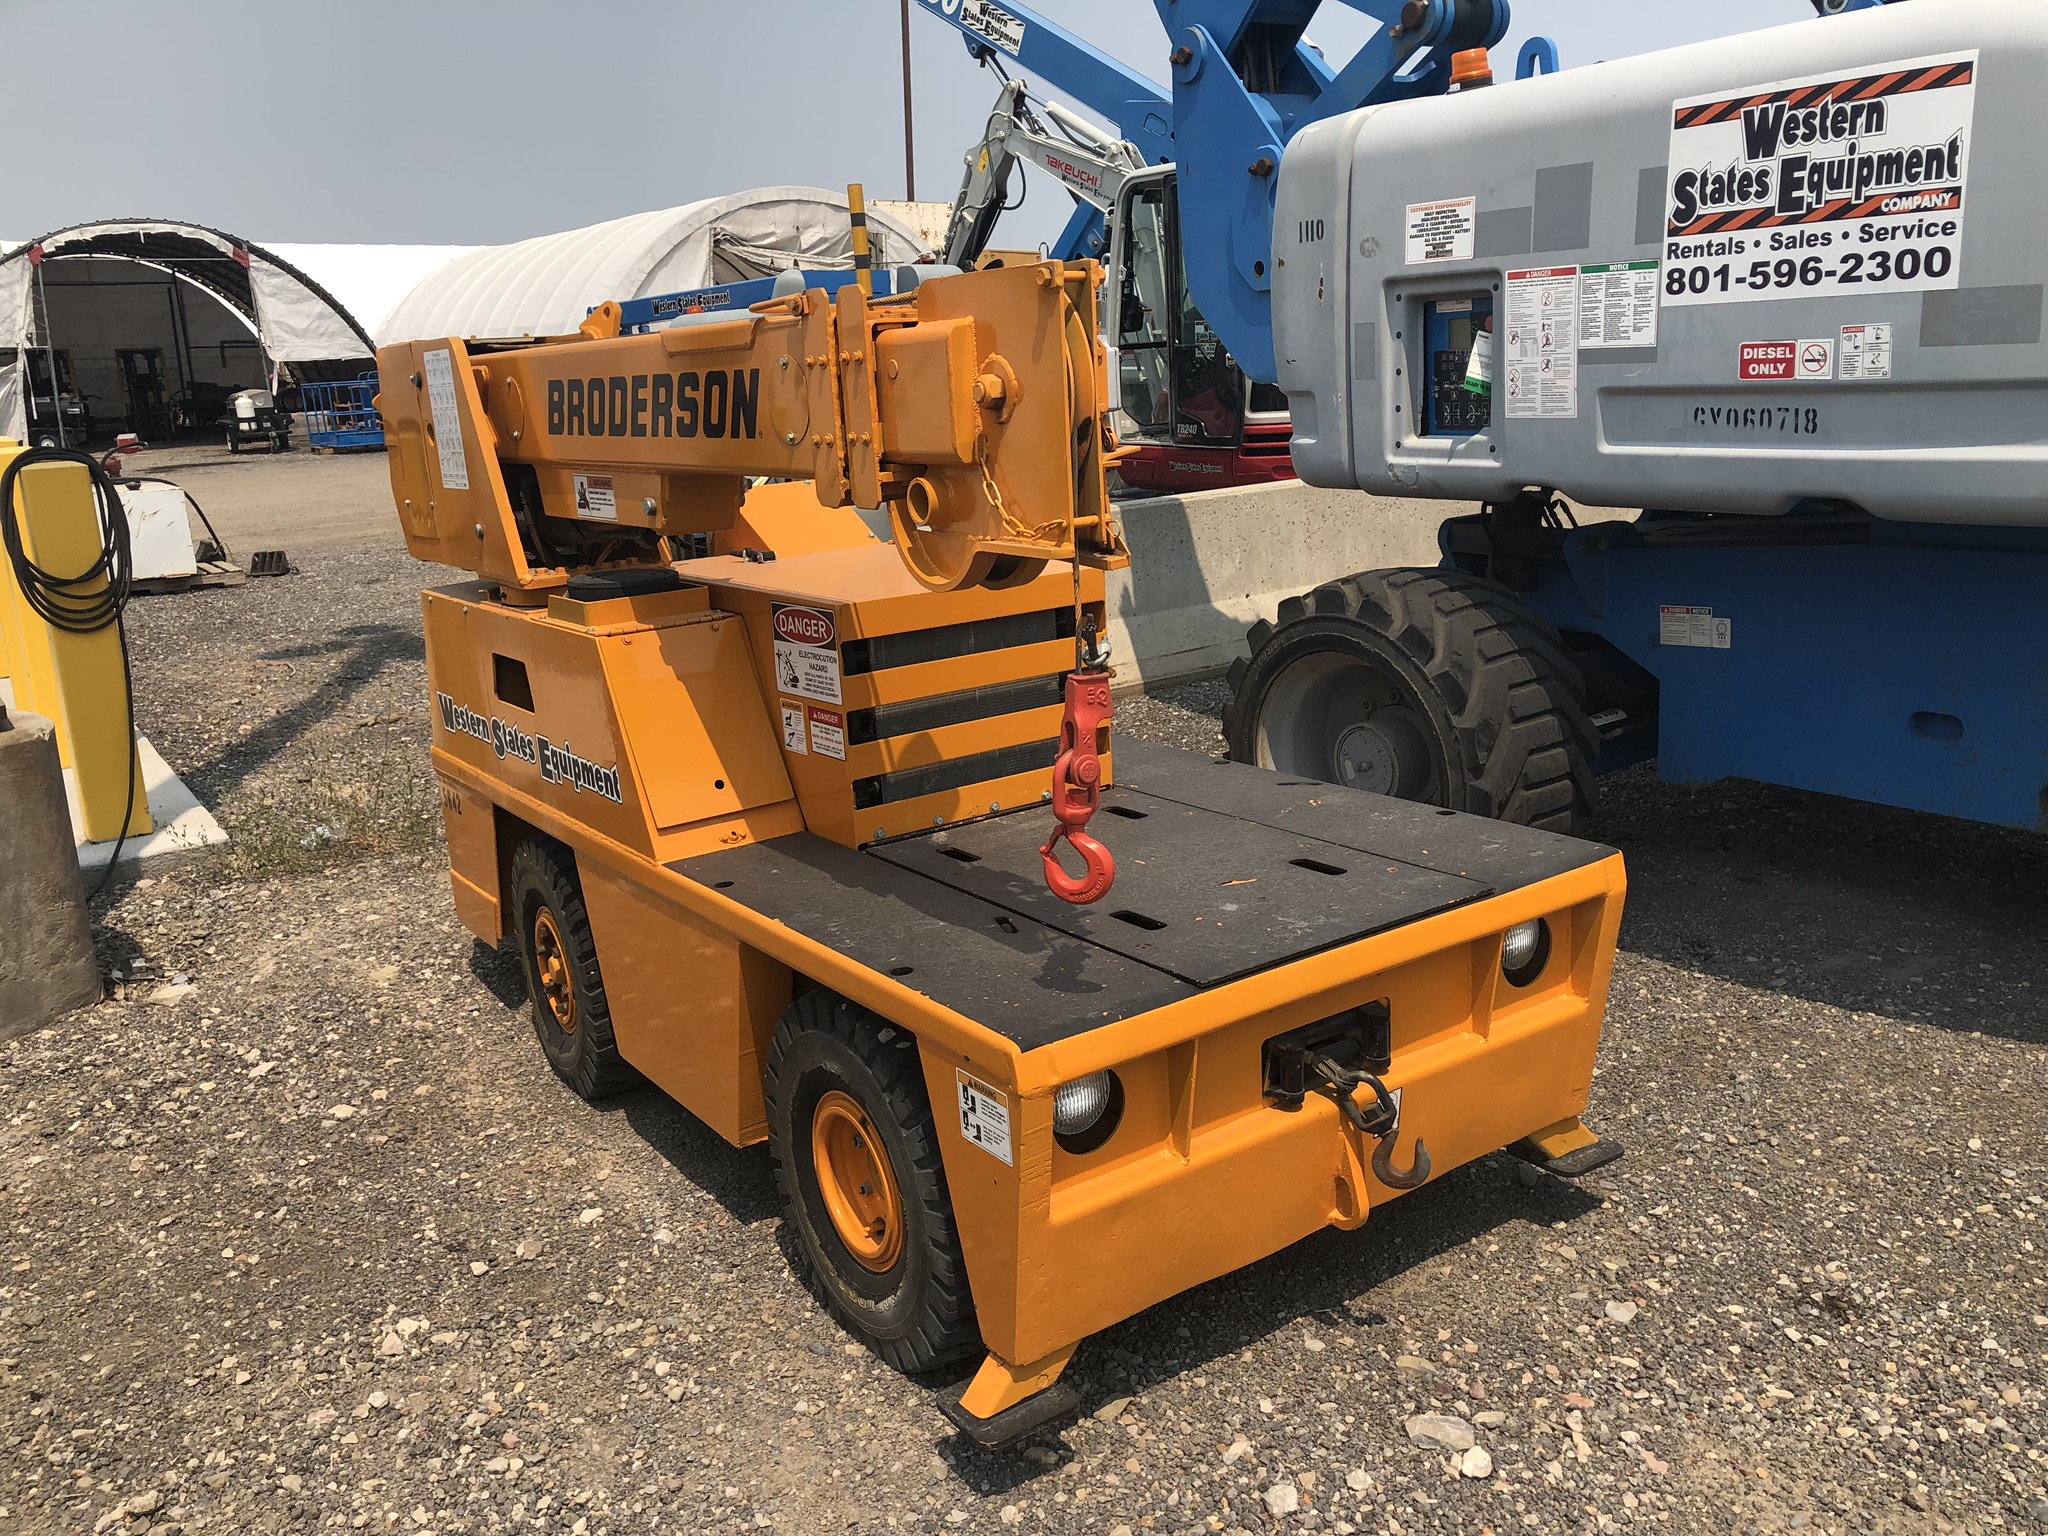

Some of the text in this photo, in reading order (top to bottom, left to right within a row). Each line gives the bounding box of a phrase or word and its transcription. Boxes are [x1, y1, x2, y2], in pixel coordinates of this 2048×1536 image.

[961, 7, 1019, 48] States Equipment
[980, 3, 1008, 28] Western
[1742, 98, 1886, 158] Western
[1673, 136, 1960, 223] States Equipment
[1435, 201, 1471, 210] RESPONSIBILITY
[1881, 192, 1953, 212] COMPANY
[1667, 219, 1957, 260] Rentals Sales Service
[1665, 247, 1951, 295] 801-596-2300
[652, 289, 730, 316] Western States Equipment
[1743, 347, 1793, 360] DIESEL
[1749, 363, 1786, 375] ONLY
[548, 368, 760, 440] BRODERSON
[1177, 424, 1197, 434] TB240
[780, 615, 827, 639] DANGER
[799, 650, 837, 664] ELECTROCUTION
[809, 663, 828, 673] HAZARD
[818, 712, 838, 724] DANGER
[437, 691, 622, 803] Western States Equipment
[974, 1083, 996, 1100] WARNING
